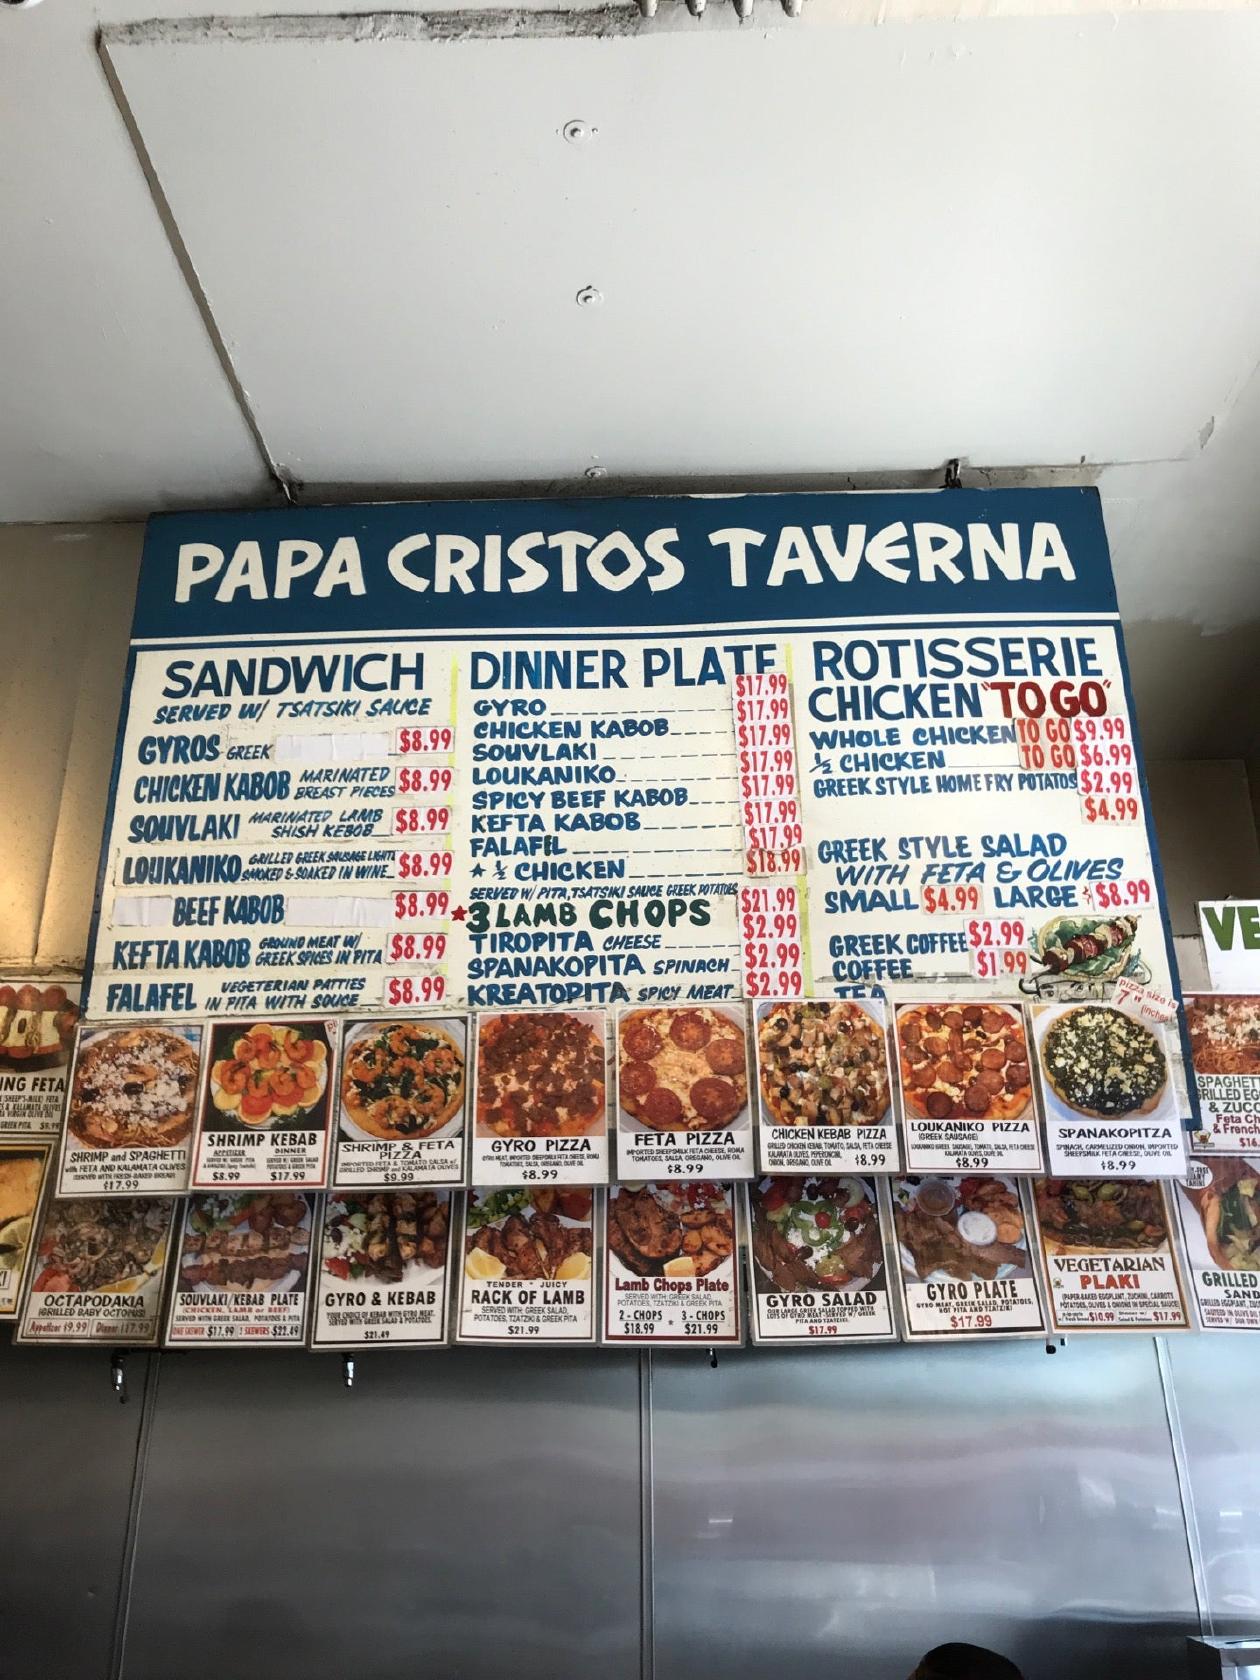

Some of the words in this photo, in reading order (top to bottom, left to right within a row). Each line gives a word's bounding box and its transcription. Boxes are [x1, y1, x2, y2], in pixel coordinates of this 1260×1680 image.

[175, 536, 366, 602] PAPA
[388, 528, 684, 594] CRISTOS
[708, 521, 1076, 587] TAVERNA
[470, 649, 629, 690] DINNER
[812, 637, 1102, 681] ROTISSERIE
[162, 653, 424, 698] SANDWICH
[736, 674, 787, 697] $17.99
[153, 702, 232, 724] SERVED
[238, 699, 269, 722] W/
[277, 699, 360, 718] TSATSIKI
[366, 698, 432, 717] SAUCE
[473, 699, 546, 716] GYRO
[737, 698, 788, 723] $17.99
[808, 682, 983, 723] CHICKEN
[400, 728, 451, 753] $8.99
[473, 721, 581, 739] CHICKEN
[591, 719, 669, 738] KABOB
[739, 724, 790, 748] $17.99
[809, 728, 901, 750] WHOLE
[912, 725, 1016, 746] CHICKEN
[1017, 719, 1040, 743] TO
[1046, 718, 1070, 742] GO
[1074, 718, 1125, 742] $9.99
[138, 734, 220, 765] GYROS
[227, 744, 274, 760] GREEK
[472, 743, 596, 762] SOUVLAKI
[840, 750, 946, 773] CHICKEN
[1021, 745, 1044, 769] TO
[1051, 745, 1075, 768] GO
[1080, 743, 1131, 767] $6.99
[740, 750, 793, 774] $17.99
[300, 766, 390, 783] MARINATED
[398, 768, 452, 793] $8.99
[472, 765, 616, 785] LOUKANIKO
[813, 777, 872, 798] GREEK
[875, 776, 932, 795] STYLE
[935, 773, 982, 793] HOME
[983, 774, 1013, 791] FRY
[1080, 769, 1132, 794] $2.99
[134, 773, 221, 804] CHICKEN
[223, 770, 291, 801] KABOB
[294, 786, 348, 800] BREAST
[350, 786, 395, 798] PIECES
[472, 791, 545, 810] SPICY
[551, 790, 606, 808] BEEF
[614, 788, 688, 808] KABOB
[742, 775, 794, 799] $17.99
[248, 809, 332, 824] MARINATED
[340, 809, 383, 822] LAMB
[395, 808, 449, 833] $8.99
[744, 801, 796, 826] $17.99
[1085, 796, 1138, 823] $4.99
[128, 814, 240, 843] SOUVLAKI
[271, 825, 319, 839] SHISH
[472, 813, 546, 833] KEFTA
[554, 812, 641, 832] KABOB
[749, 824, 801, 849] $17.99
[818, 837, 888, 864] GREEK
[899, 836, 972, 859] STYLE
[981, 833, 1067, 858] SALAD
[123, 854, 242, 885] LOUKANIKO
[399, 852, 452, 878] $8.99
[515, 859, 625, 881] CHICKEN
[836, 864, 909, 886] WITH
[921, 862, 985, 884] FETA
[1027, 858, 1123, 881] OLIVES
[469, 886, 519, 900] SERVED
[741, 887, 795, 913] $21.99
[825, 888, 919, 914] SMALL
[923, 886, 978, 914] $4.99
[994, 886, 1078, 908] LARGE
[1095, 880, 1150, 909] $8.99
[173, 896, 221, 927] BEEF
[223, 893, 285, 925] KABOB
[395, 892, 449, 919] $8.99
[466, 901, 490, 933] 3
[496, 902, 577, 927] LAMB
[589, 898, 711, 929] CHOPS
[743, 914, 797, 939] $2.99
[969, 920, 1024, 948] $2.99
[112, 940, 180, 970] KEFTA
[184, 938, 251, 969] KABOB
[390, 933, 446, 960] $8.99
[469, 931, 593, 954] TIROPITA
[603, 934, 661, 951] CHEESE
[829, 934, 903, 958] GREEK
[907, 932, 970, 954] COFFEE
[467, 953, 645, 979] SPANAKOPITA
[653, 958, 730, 975] SPINACH
[745, 942, 800, 969] $2.99
[977, 949, 1027, 977] $1.99
[832, 959, 913, 982] COFFEE
[221, 979, 309, 993] VEGETERIAN
[389, 977, 445, 1005] $8.99
[467, 981, 630, 1006] KREATOPITA
[637, 985, 681, 1001] SPICY
[687, 984, 735, 999] MEAT
[746, 971, 801, 997] $2.99
[834, 984, 887, 998] TEA
[106, 983, 197, 1012] FALAFEL
[32, 1078, 64, 1092] FETA
[635, 1133, 676, 1146] FETA
[687, 1132, 735, 1145] PIZZA
[772, 1128, 814, 1140] CHICKEN
[818, 1129, 851, 1140] KEBAB
[858, 1129, 886, 1139] PIZZA
[911, 1122, 984, 1132] LOUKANIKO
[992, 1123, 1030, 1132] PIZZA
[1059, 1128, 1172, 1138] SPANAKOPITZA
[208, 1133, 265, 1147] SHRIMP
[271, 1133, 317, 1146] KEBAB
[342, 1143, 396, 1152] SHRIMP
[420, 1141, 454, 1150] FETA
[492, 1139, 536, 1152] GYRO
[546, 1139, 591, 1151] PIZZA
[70, 1152, 108, 1163] SHRIMP
[129, 1150, 186, 1160] SPAGHETTI
[380, 1151, 421, 1159] PIZZA
[855, 1154, 885, 1165] $8.99
[956, 1158, 989, 1167] $8.99
[1101, 1161, 1136, 1170] $8.99
[522, 1170, 558, 1179] $8.99
[668, 1164, 703, 1173] $8.99
[1054, 1257, 1165, 1272] VEGETARIAN
[616, 1278, 649, 1291] Lamb
[654, 1278, 692, 1293] Chops
[696, 1279, 729, 1291] Plate
[927, 1283, 967, 1301] GYRO
[974, 1280, 1017, 1299] PLATE
[1080, 1274, 1140, 1289] PLAKI
[1202, 1271, 1258, 1288] GRILLED
[44, 1295, 144, 1307] OCTAPODAKIA
[180, 1294, 264, 1308] SOUVLAKI/KEBAB
[271, 1294, 298, 1305] PLATE
[326, 1292, 366, 1306] GYRO
[388, 1291, 436, 1305] KEBAB
[472, 1290, 512, 1304] RACK
[519, 1290, 537, 1304] OF
[543, 1290, 585, 1304] LAMB
[766, 1294, 815, 1307] GYRO
[822, 1292, 877, 1306] SALAD
[508, 1326, 539, 1334] $21.99
[625, 1323, 654, 1334] $18.99
[685, 1323, 718, 1334] $21.99
[950, 1315, 992, 1328] $17.99
